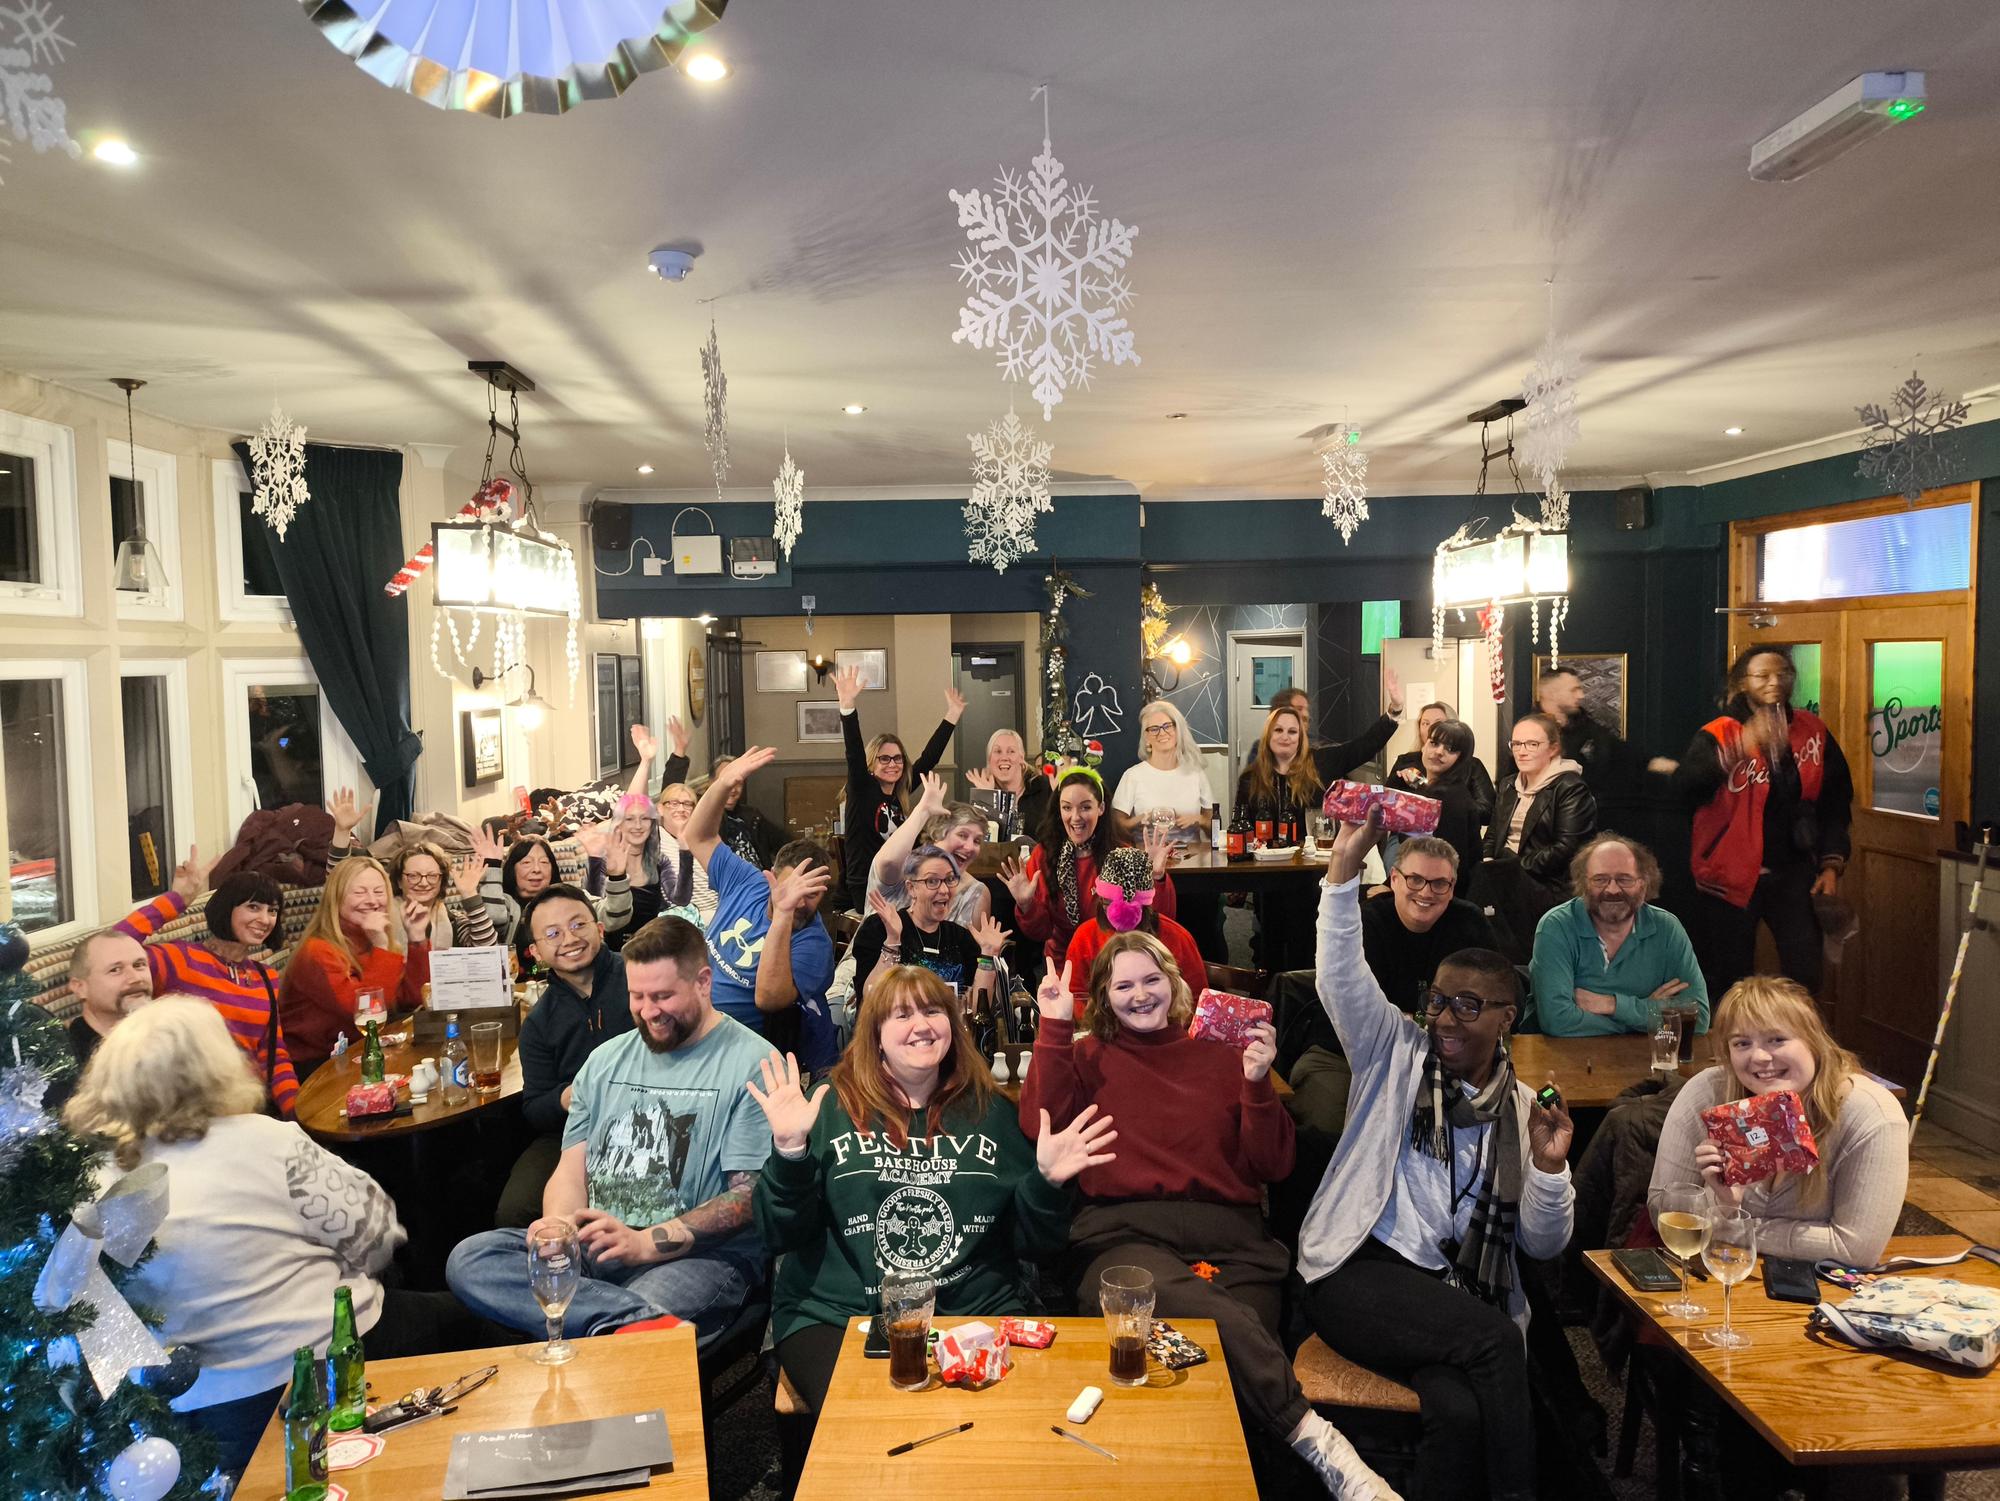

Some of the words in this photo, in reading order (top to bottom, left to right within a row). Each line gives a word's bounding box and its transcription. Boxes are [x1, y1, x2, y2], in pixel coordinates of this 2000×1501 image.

[718, 960, 750, 987] ARMOUR
[1749, 1132, 1761, 1141] 12
[830, 1131, 998, 1166] FESTIVE
[874, 1156, 958, 1171] BAKEHOUSE
[878, 1168, 953, 1186] ACADEMY
[880, 1192, 902, 1218] GOODS
[907, 1188, 941, 1205] FRESHLY
[847, 1213, 869, 1226] HAND
[938, 1200, 951, 1233] BAKED
[843, 1223, 875, 1236] CRAFTED
[878, 1220, 890, 1251] BAKED
[930, 1235, 950, 1261] GOODS
[887, 1250, 925, 1267] FRESHLY
